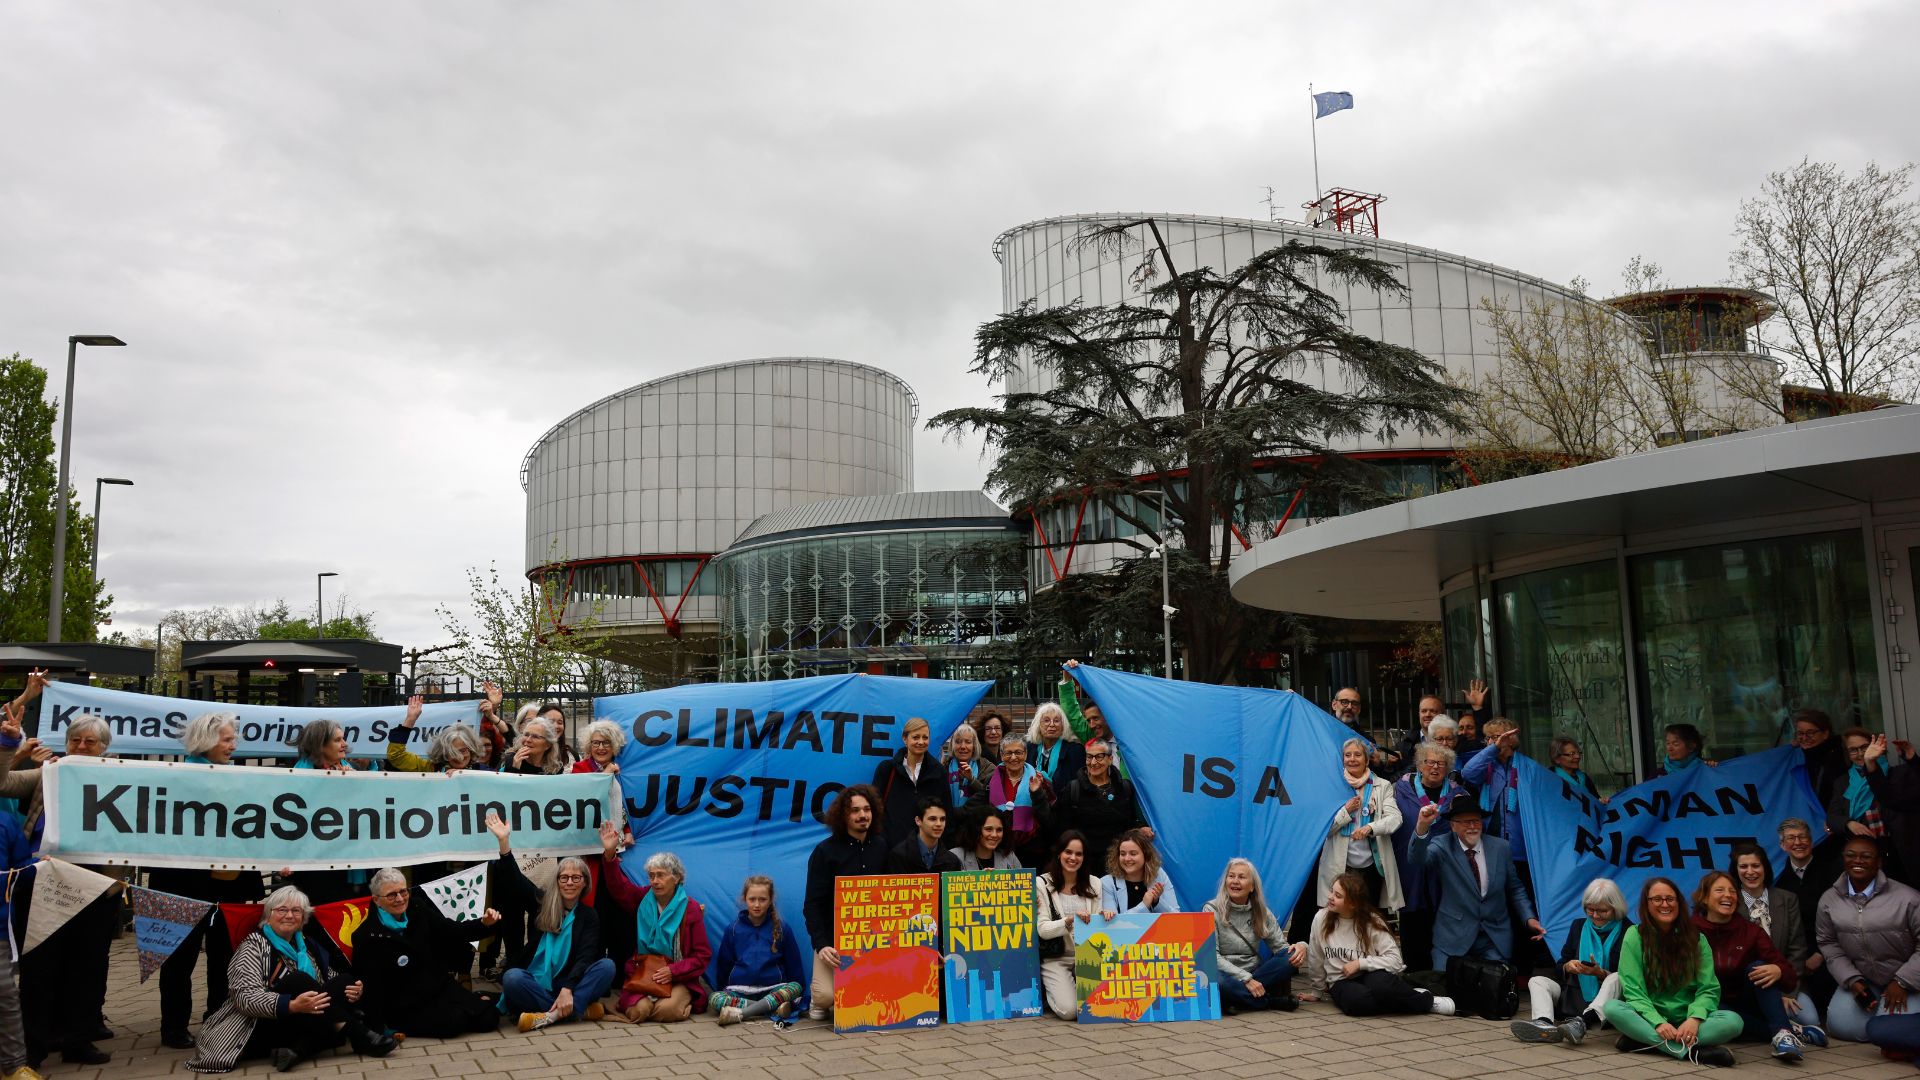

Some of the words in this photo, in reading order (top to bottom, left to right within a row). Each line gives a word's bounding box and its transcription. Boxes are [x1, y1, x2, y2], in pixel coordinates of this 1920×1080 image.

[632, 708, 895, 757] CLIMATE
[1182, 754, 1235, 799] IS
[1253, 765, 1292, 806] A
[626, 773, 845, 824] JUSTIC
[83, 784, 601, 841] KlimaSeniorinnen
[840, 880, 853, 888] TO
[857, 879, 879, 887] OUR
[882, 877, 934, 887] LEADERS:
[948, 880, 1032, 892] GOVERNMENTS:
[842, 890, 871, 903] WE
[949, 889, 1032, 907] CLIMATE
[841, 903, 913, 918] FORGET
[921, 902, 932, 915] &
[949, 905, 1032, 926] ACTION
[147, 922, 171, 935] Fahr
[842, 920, 870, 933] WE
[840, 933, 890, 950] GIVE
[899, 931, 934, 948] UP!
[950, 923, 1033, 952] NOW!
[1101, 942, 1193, 962] #YOUTH4
[1100, 961, 1196, 981] CLIMATE
[1102, 979, 1197, 999] JUSTICE
